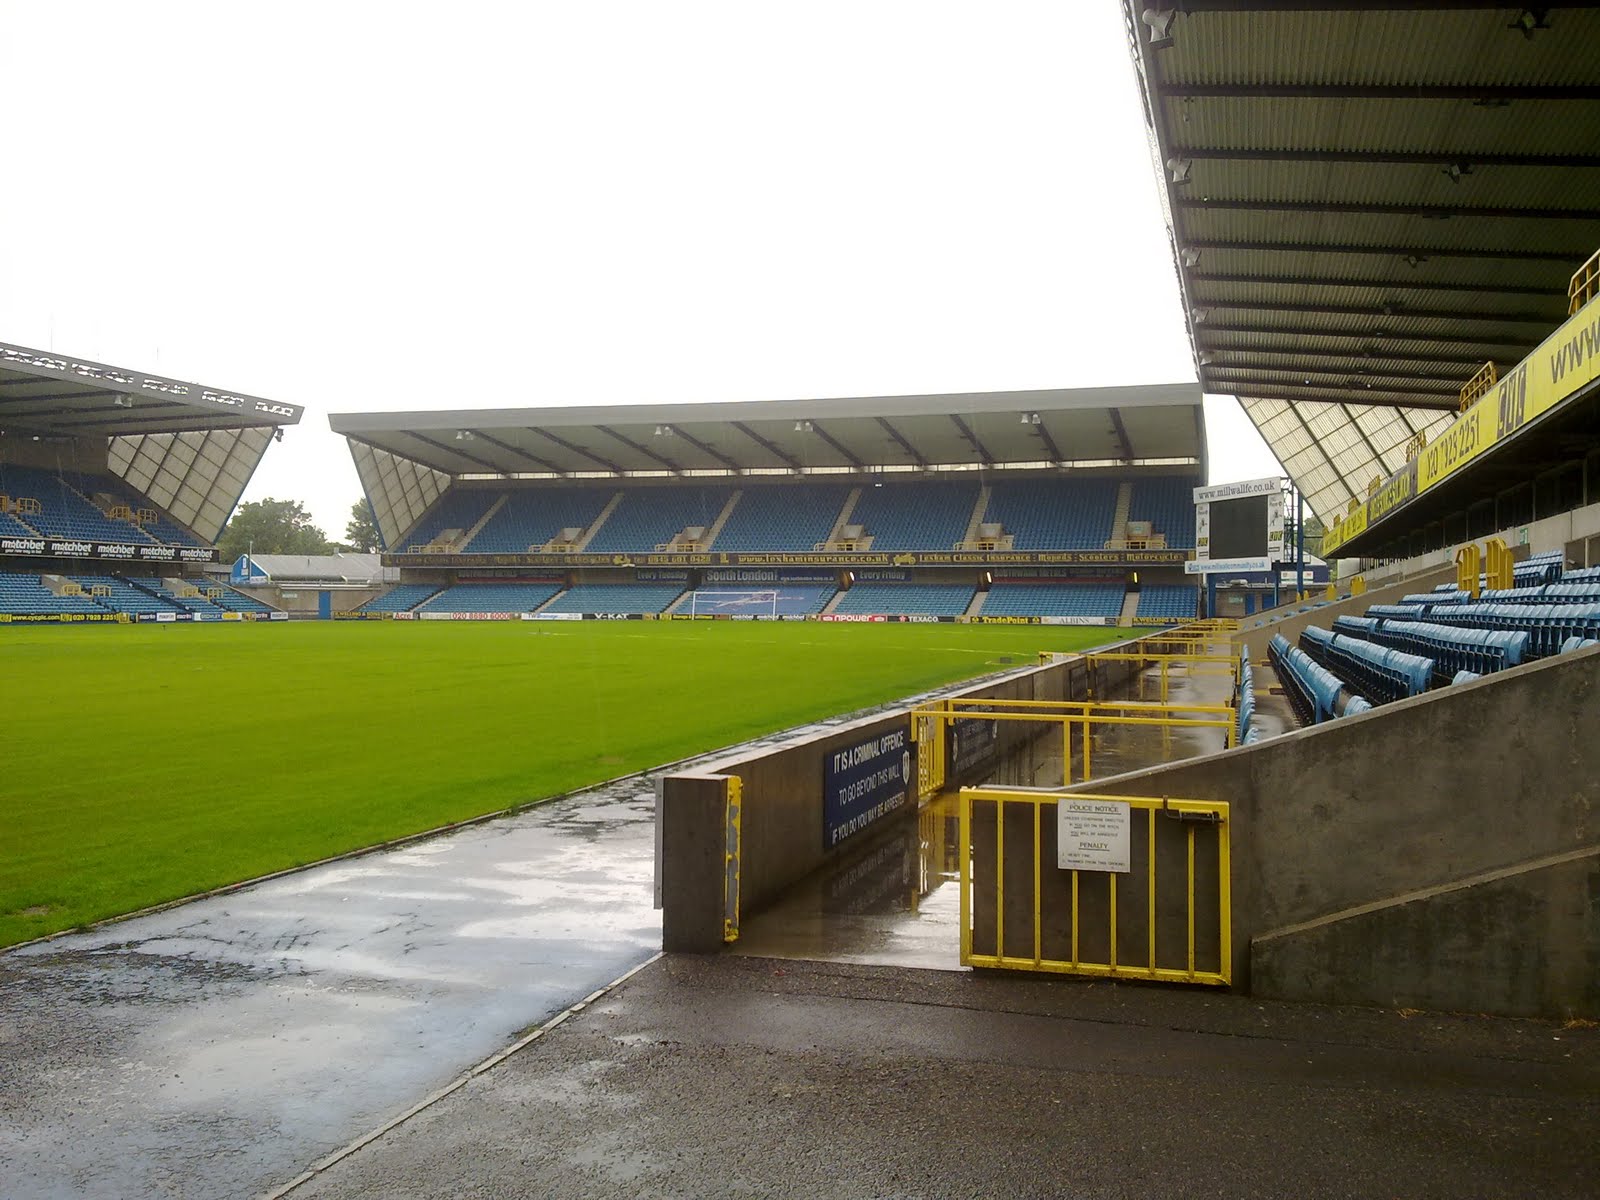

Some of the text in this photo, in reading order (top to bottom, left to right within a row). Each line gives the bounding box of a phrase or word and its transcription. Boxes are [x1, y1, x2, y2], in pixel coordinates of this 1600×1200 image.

[1460, 410, 1480, 457] 2251
[2, 540, 45, 550] matchbet
[52, 542, 92, 552] matchbet
[97, 544, 135, 554] matchbet
[140, 546, 175, 556] matchbet
[180, 549, 213, 558] matchbet
[834, 730, 904, 774] IT IS A CRIMINAL OFFENCE
[839, 763, 900, 806] TO GO BEYOND THIS WALL
[1069, 804, 1118, 813] POLICE NOTICE
[832, 791, 905, 845] IF YOU DO YOU MAY BE ARRESTED
